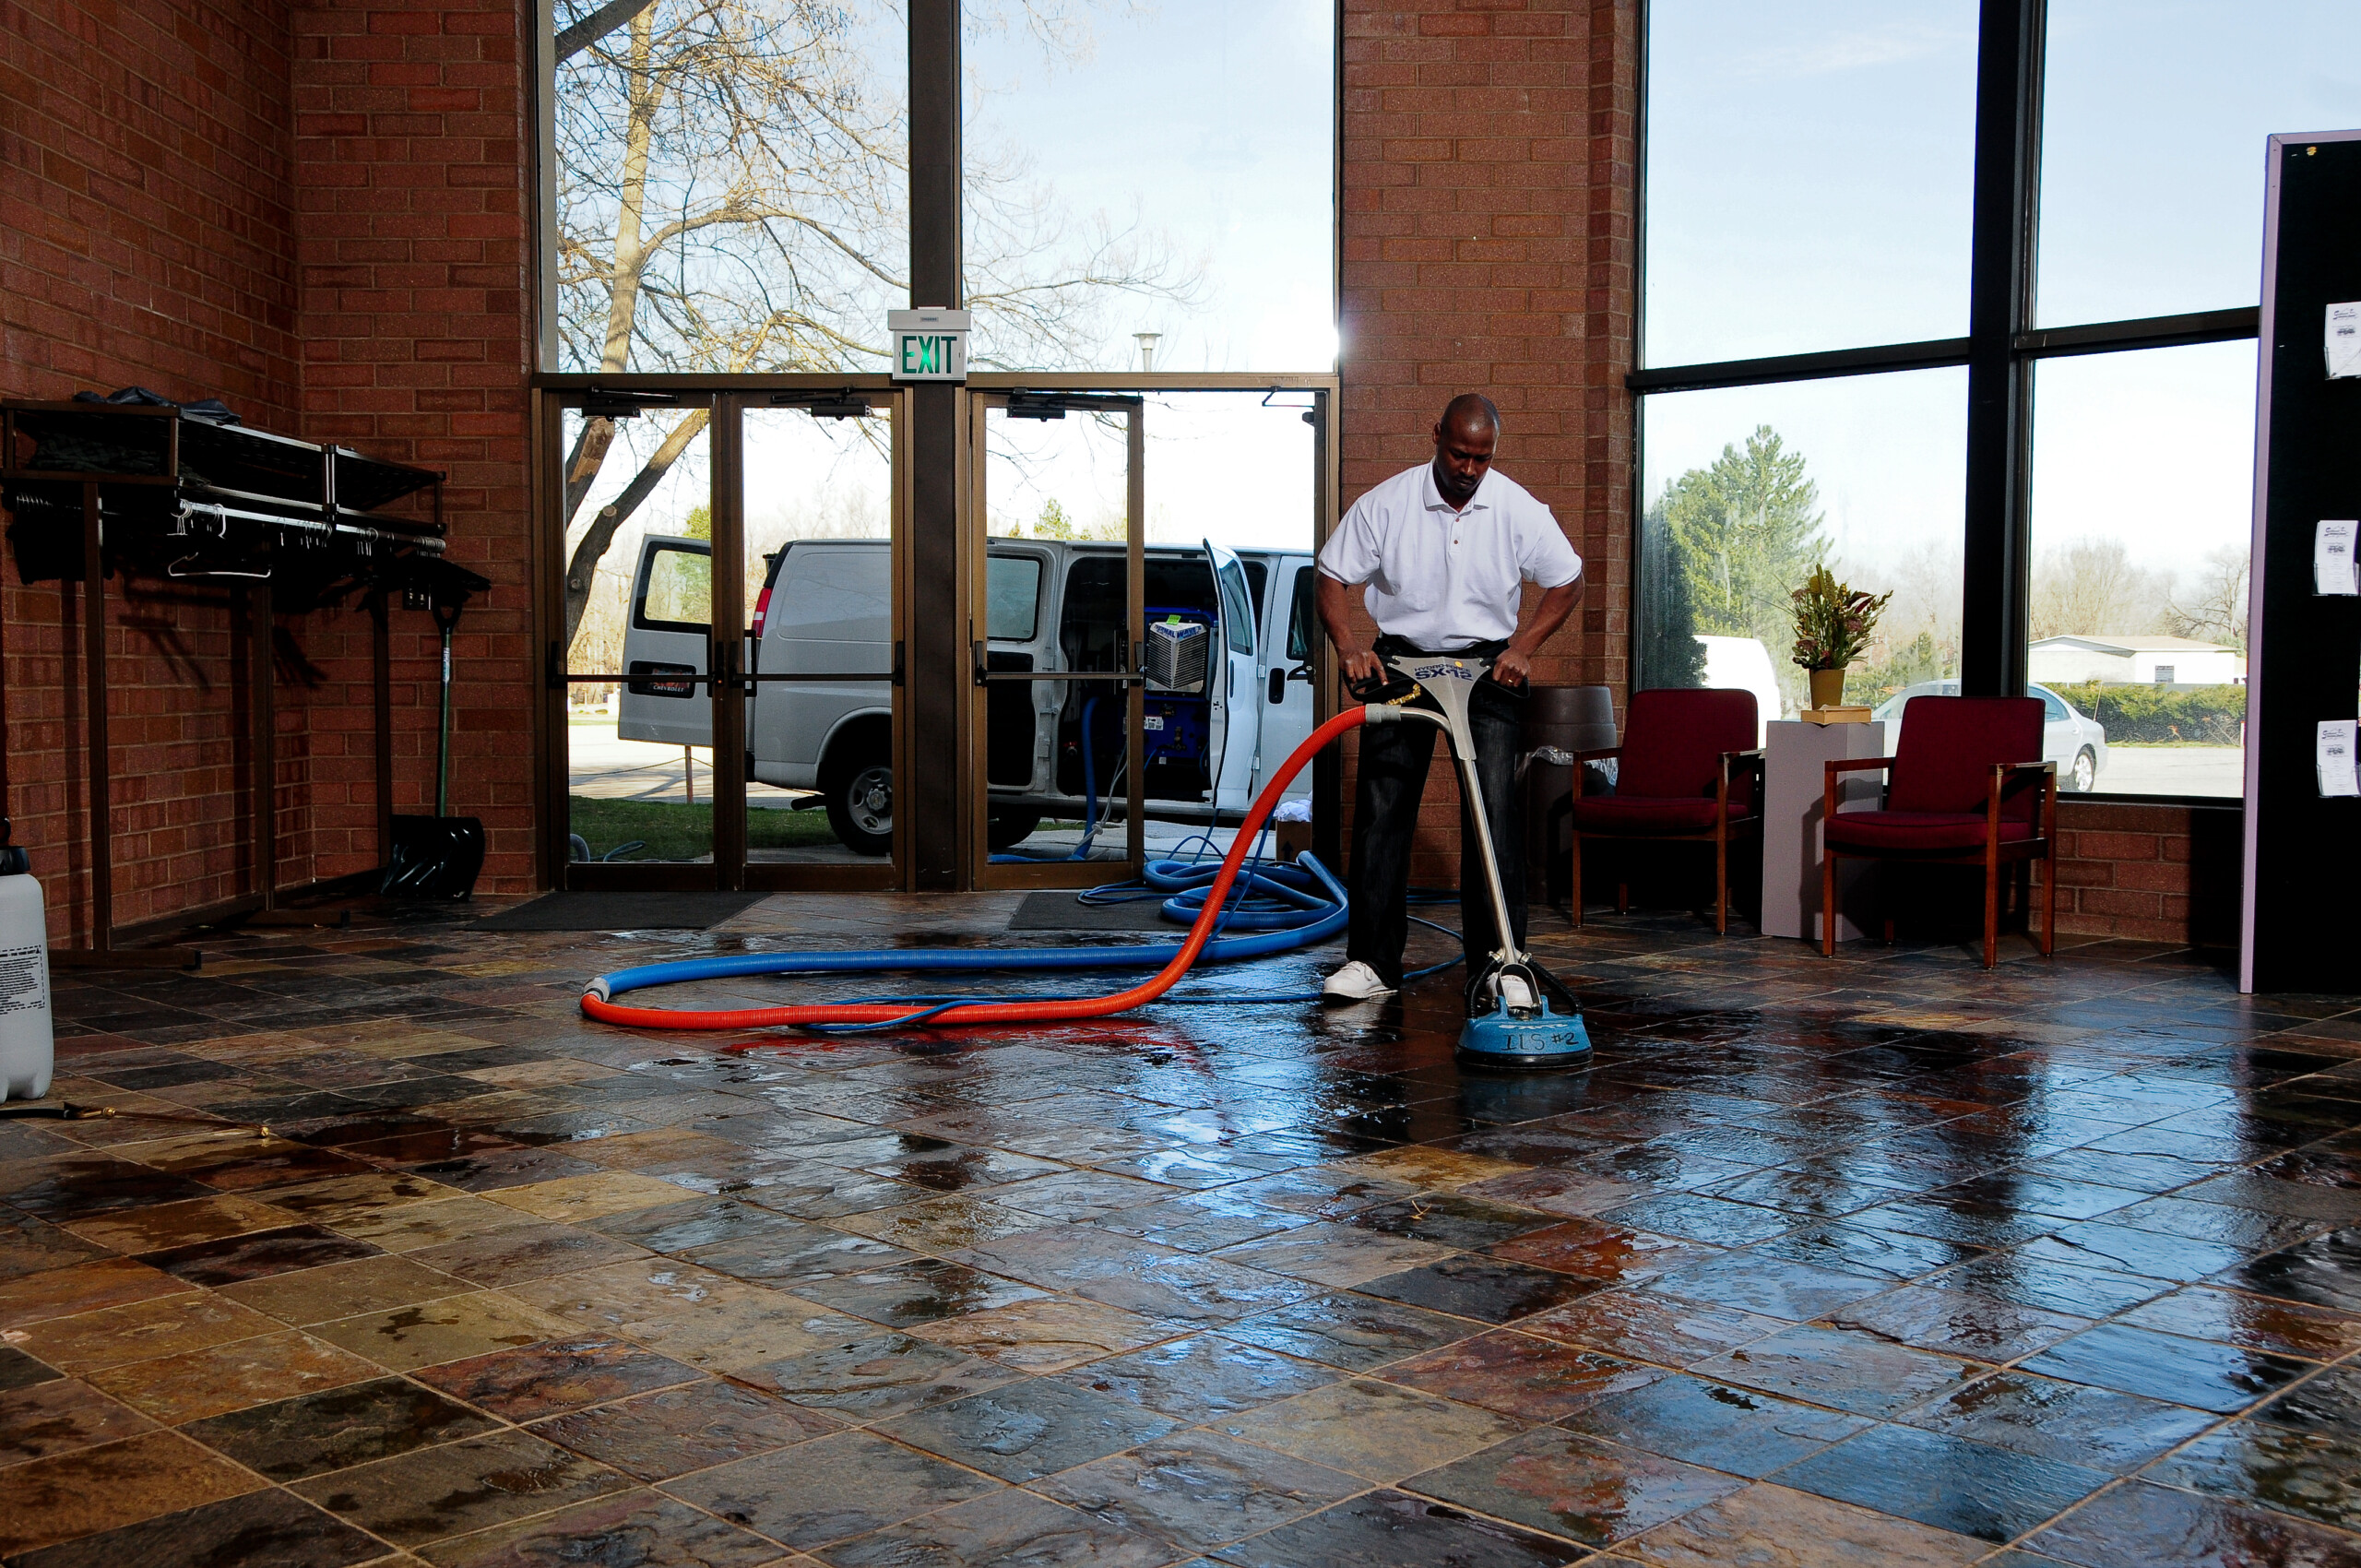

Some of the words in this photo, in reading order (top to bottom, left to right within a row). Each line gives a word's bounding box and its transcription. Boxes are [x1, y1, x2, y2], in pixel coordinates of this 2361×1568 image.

[902, 336, 957, 374] EXIT
[653, 684, 684, 693] CHEVROLET
[1550, 1031, 1580, 1046] #2
